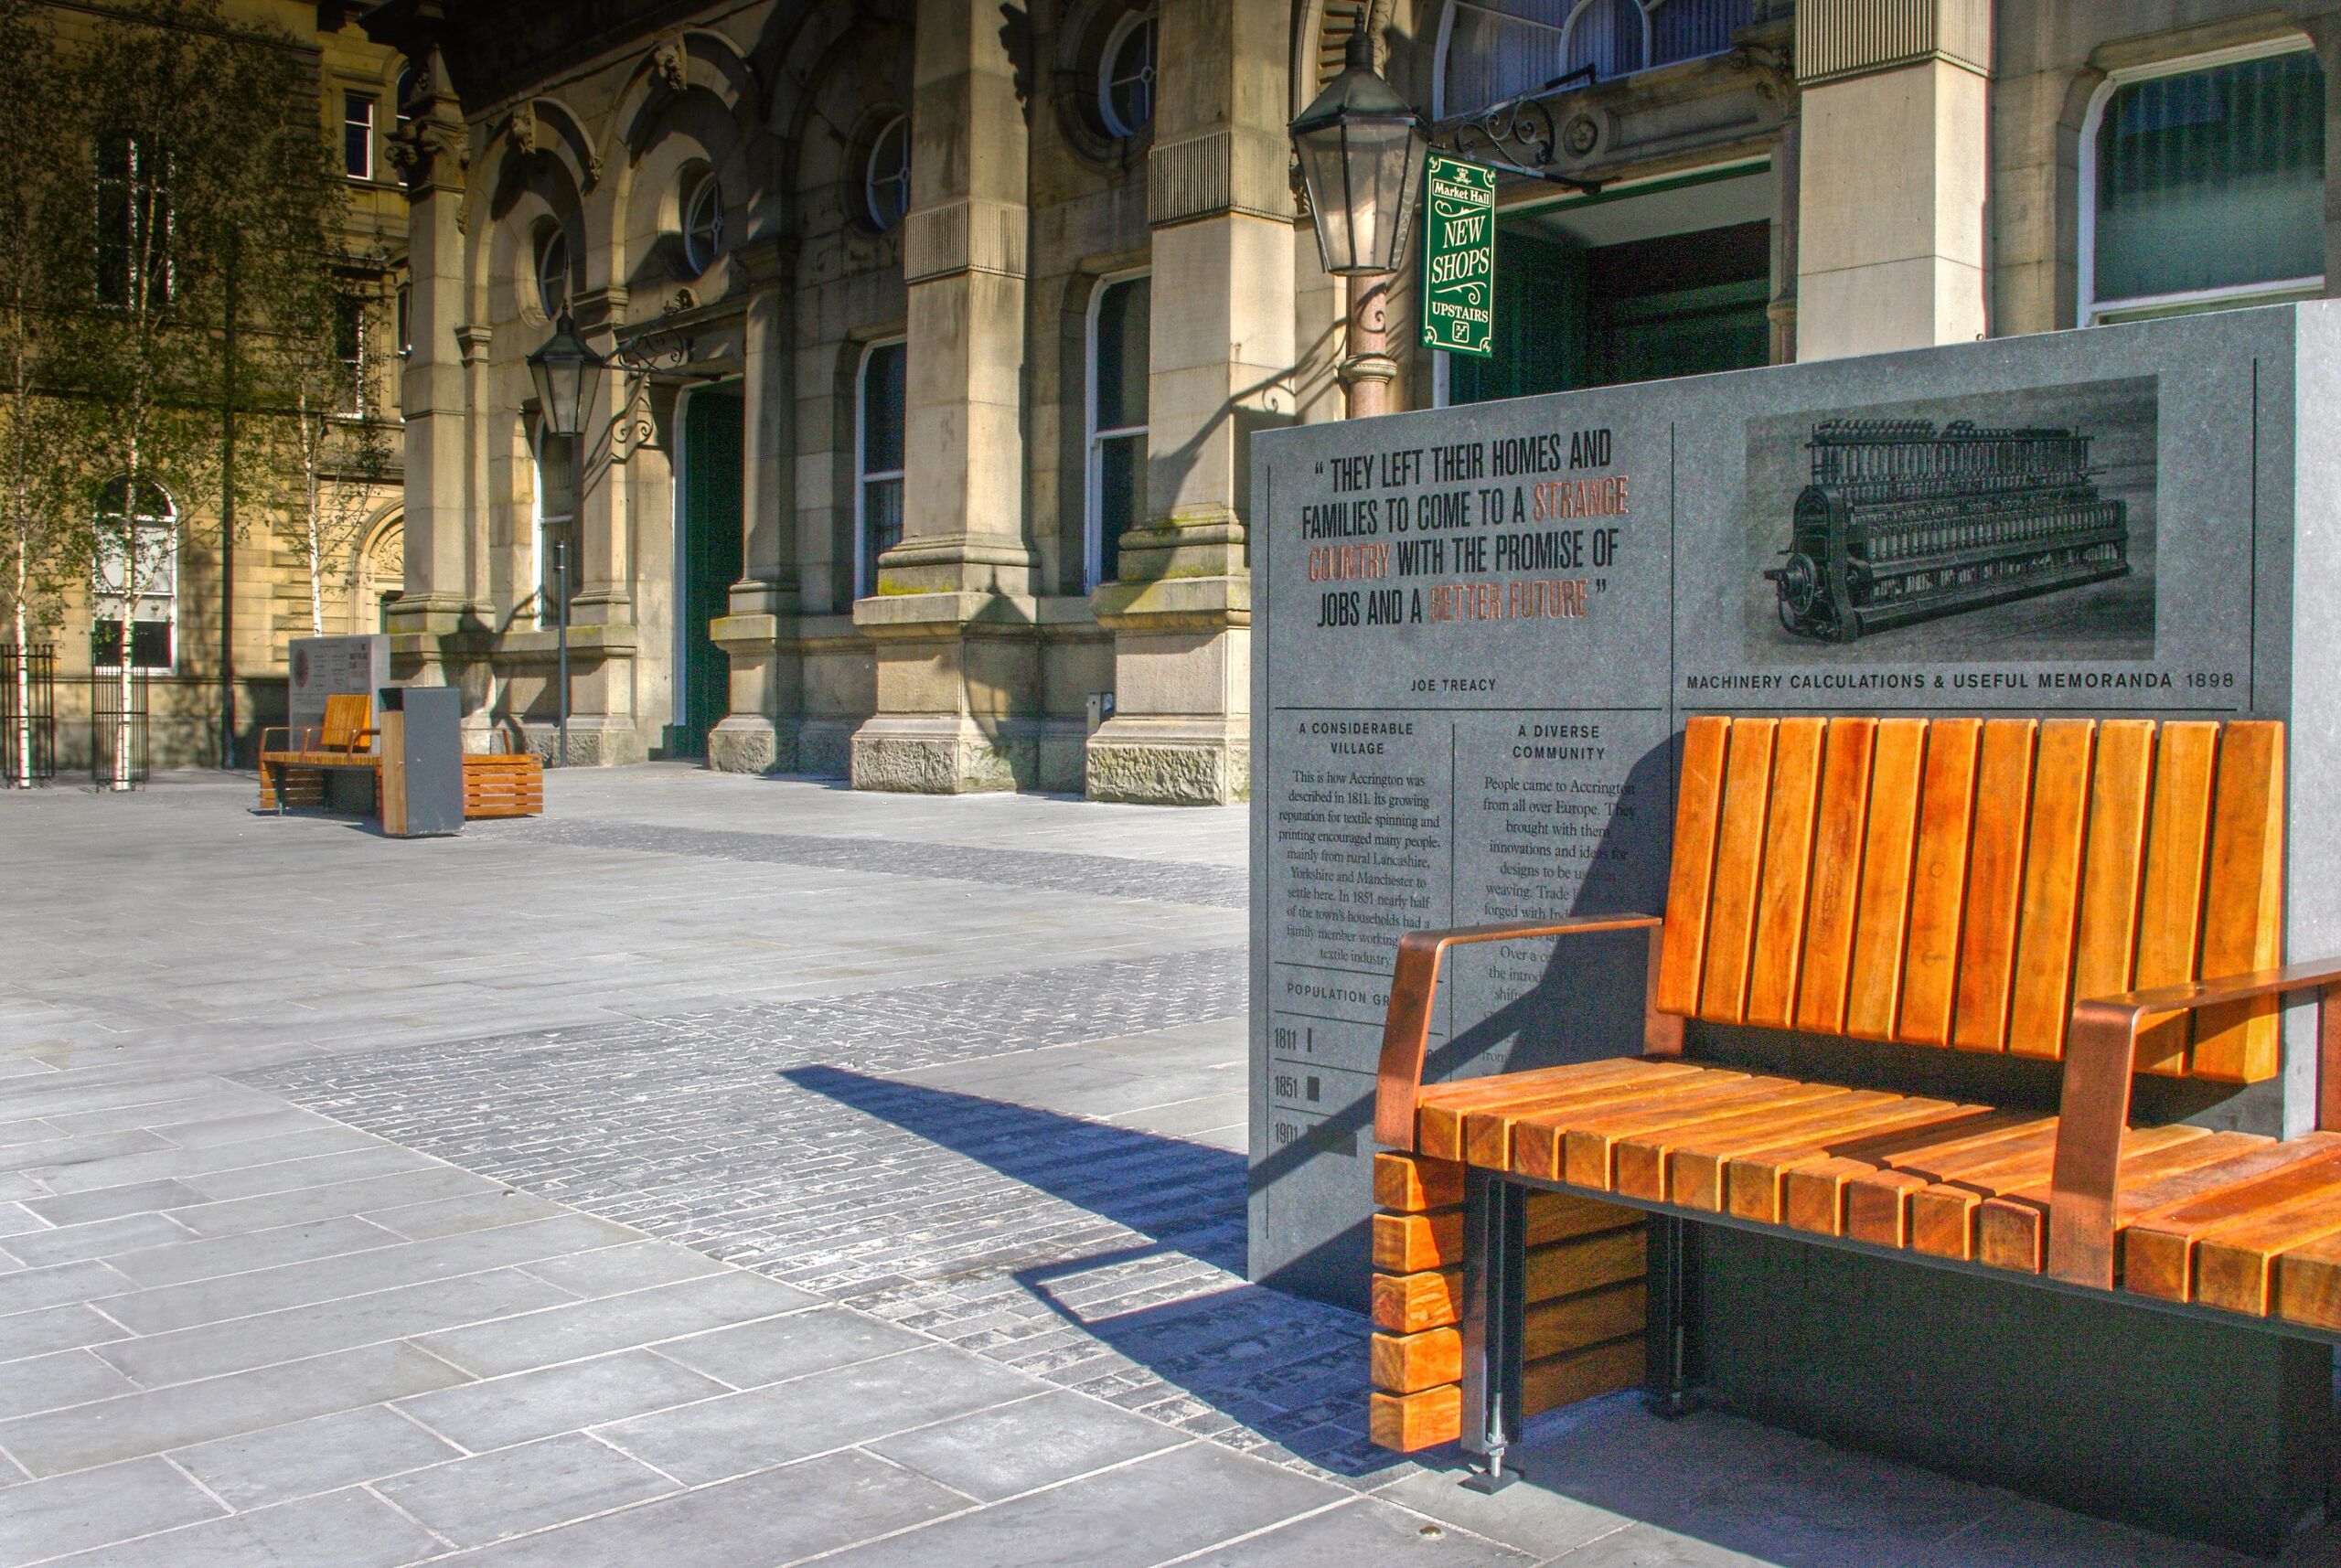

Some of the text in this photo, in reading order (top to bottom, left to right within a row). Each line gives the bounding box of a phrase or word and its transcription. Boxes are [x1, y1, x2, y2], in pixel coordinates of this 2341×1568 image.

[1434, 182, 1490, 205] Market Hall
[1443, 215, 1486, 249] NEW
[1431, 248, 1490, 284] SHOPS
[1432, 301, 1489, 323] UPSTAIRS
[1331, 454, 1374, 492] THEY
[1382, 449, 1424, 487] LEFT
[1431, 443, 1483, 483] THEIR
[1493, 433, 1560, 477] HOMES
[1570, 429, 1611, 469] AND
[1302, 475, 1630, 539] FAMILIES TO COME TO A STRANGE
[1309, 528, 1619, 581] COUNTRY WITH THE PROMISE OF
[1317, 591, 1360, 627] JOBS
[1367, 589, 1403, 625] AND
[1410, 588, 1422, 624] A
[1429, 582, 1502, 622] BETTER
[1510, 578, 1588, 620] FUTURE
[1411, 677, 1497, 692] JOE TREACY
[1687, 673, 2234, 689] MACHINERY CALCULATIONS & USEFUL MEMORANDA 1898
[1299, 722, 1413, 735] A CONSIDERABLE
[1518, 725, 1600, 738] A DIVERSE
[1331, 742, 1384, 754] VILLAGE
[1513, 746, 1605, 760] COMMUNITY
[1292, 770, 1425, 787] This is how Accrington was
[1485, 776, 1520, 794] People
[1523, 781, 1552, 793] came
[1555, 782, 1566, 792] to
[1288, 790, 1429, 809] described in 1811. Its growing
[1483, 798, 1509, 812] from
[1513, 799, 1525, 813] all
[1529, 803, 1553, 813] over
[1555, 800, 1600, 817] Europe.
[1279, 810, 1439, 829] reputation for textile spinning and
[1506, 819, 1610, 837] brought with them
[1278, 828, 1315, 842] printing
[1318, 833, 1372, 847] encouraged
[1374, 837, 1402, 848] many
[1287, 849, 1319, 862] mainly
[1321, 849, 1343, 862] from
[1346, 853, 1371, 865] rural
[1490, 839, 1551, 856] innovations
[1555, 845, 1576, 858] and
[1290, 867, 1427, 888] Yorkshire and Manchester to
[1500, 861, 1539, 879] designs
[1544, 867, 1554, 878] to
[1557, 866, 1570, 879] be
[1288, 888, 1311, 900] settle
[1339, 891, 1349, 903] In
[1353, 892, 1374, 904] 1851
[1377, 895, 1408, 910] nearly
[1410, 895, 1430, 909] half
[1486, 884, 1533, 900] weaving.
[1536, 885, 1569, 901] Trade
[1287, 905, 1298, 916] of
[1299, 906, 1313, 919] the
[1348, 911, 1400, 926] households
[1403, 914, 1421, 928] had
[1485, 903, 1518, 919] forged
[1521, 906, 1545, 920] with
[1287, 924, 1398, 949] family member working
[1320, 948, 1393, 966] textile industry.
[1501, 945, 1527, 960] Over
[1530, 952, 1536, 962] a
[1489, 965, 1506, 979] the
[1288, 983, 1366, 1004] POPULATION
[1274, 1028, 1297, 1051] 1811
[1275, 1075, 1298, 1099] 1851
[1275, 1123, 1299, 1145] 1901
